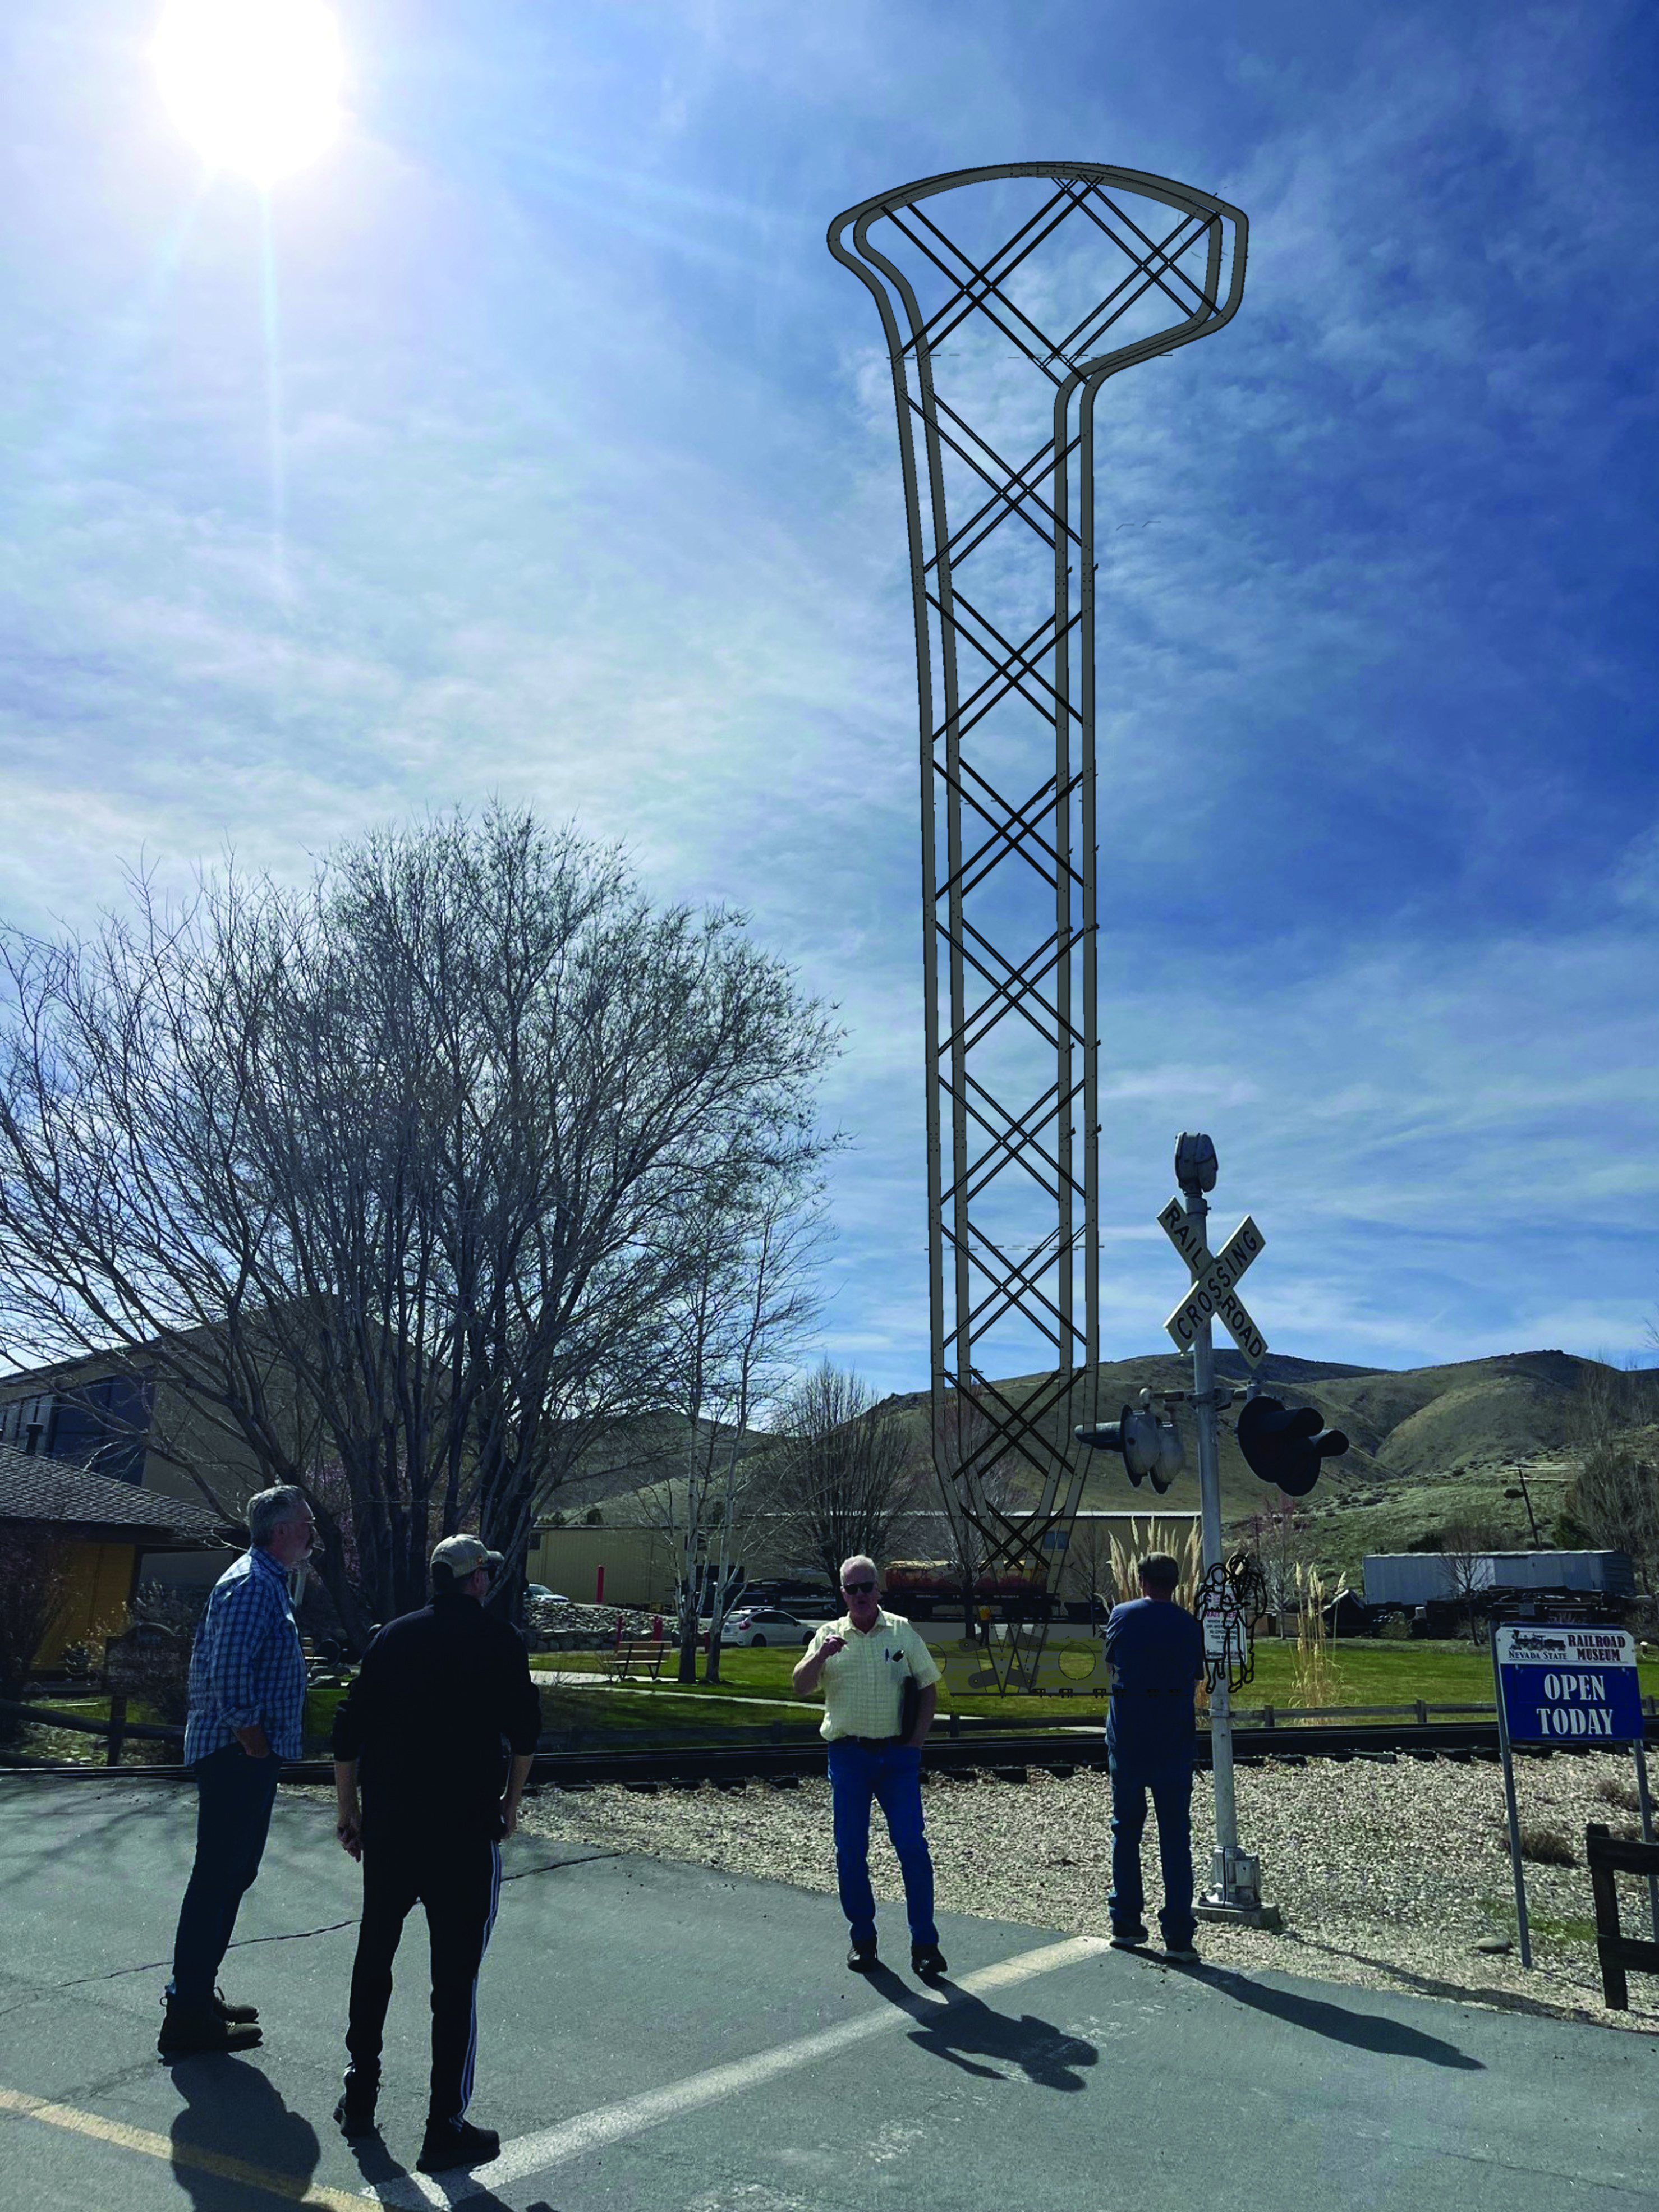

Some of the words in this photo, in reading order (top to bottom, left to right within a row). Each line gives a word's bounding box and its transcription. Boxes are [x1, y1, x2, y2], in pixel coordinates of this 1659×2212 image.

[1165, 1205, 1202, 1270] RAIL
[1221, 1294, 1262, 1358] ROAD
[1177, 1231, 1257, 1340] CROSSING
[1509, 1650, 1541, 1659] NEVADA
[1544, 1651, 1567, 1660] STATE
[1568, 1635, 1626, 1648] RAILROAD
[1577, 1648, 1620, 1661] MUSEUM
[1544, 1673, 1606, 1701] OPEN
[1536, 1708, 1613, 1735] TODAY
